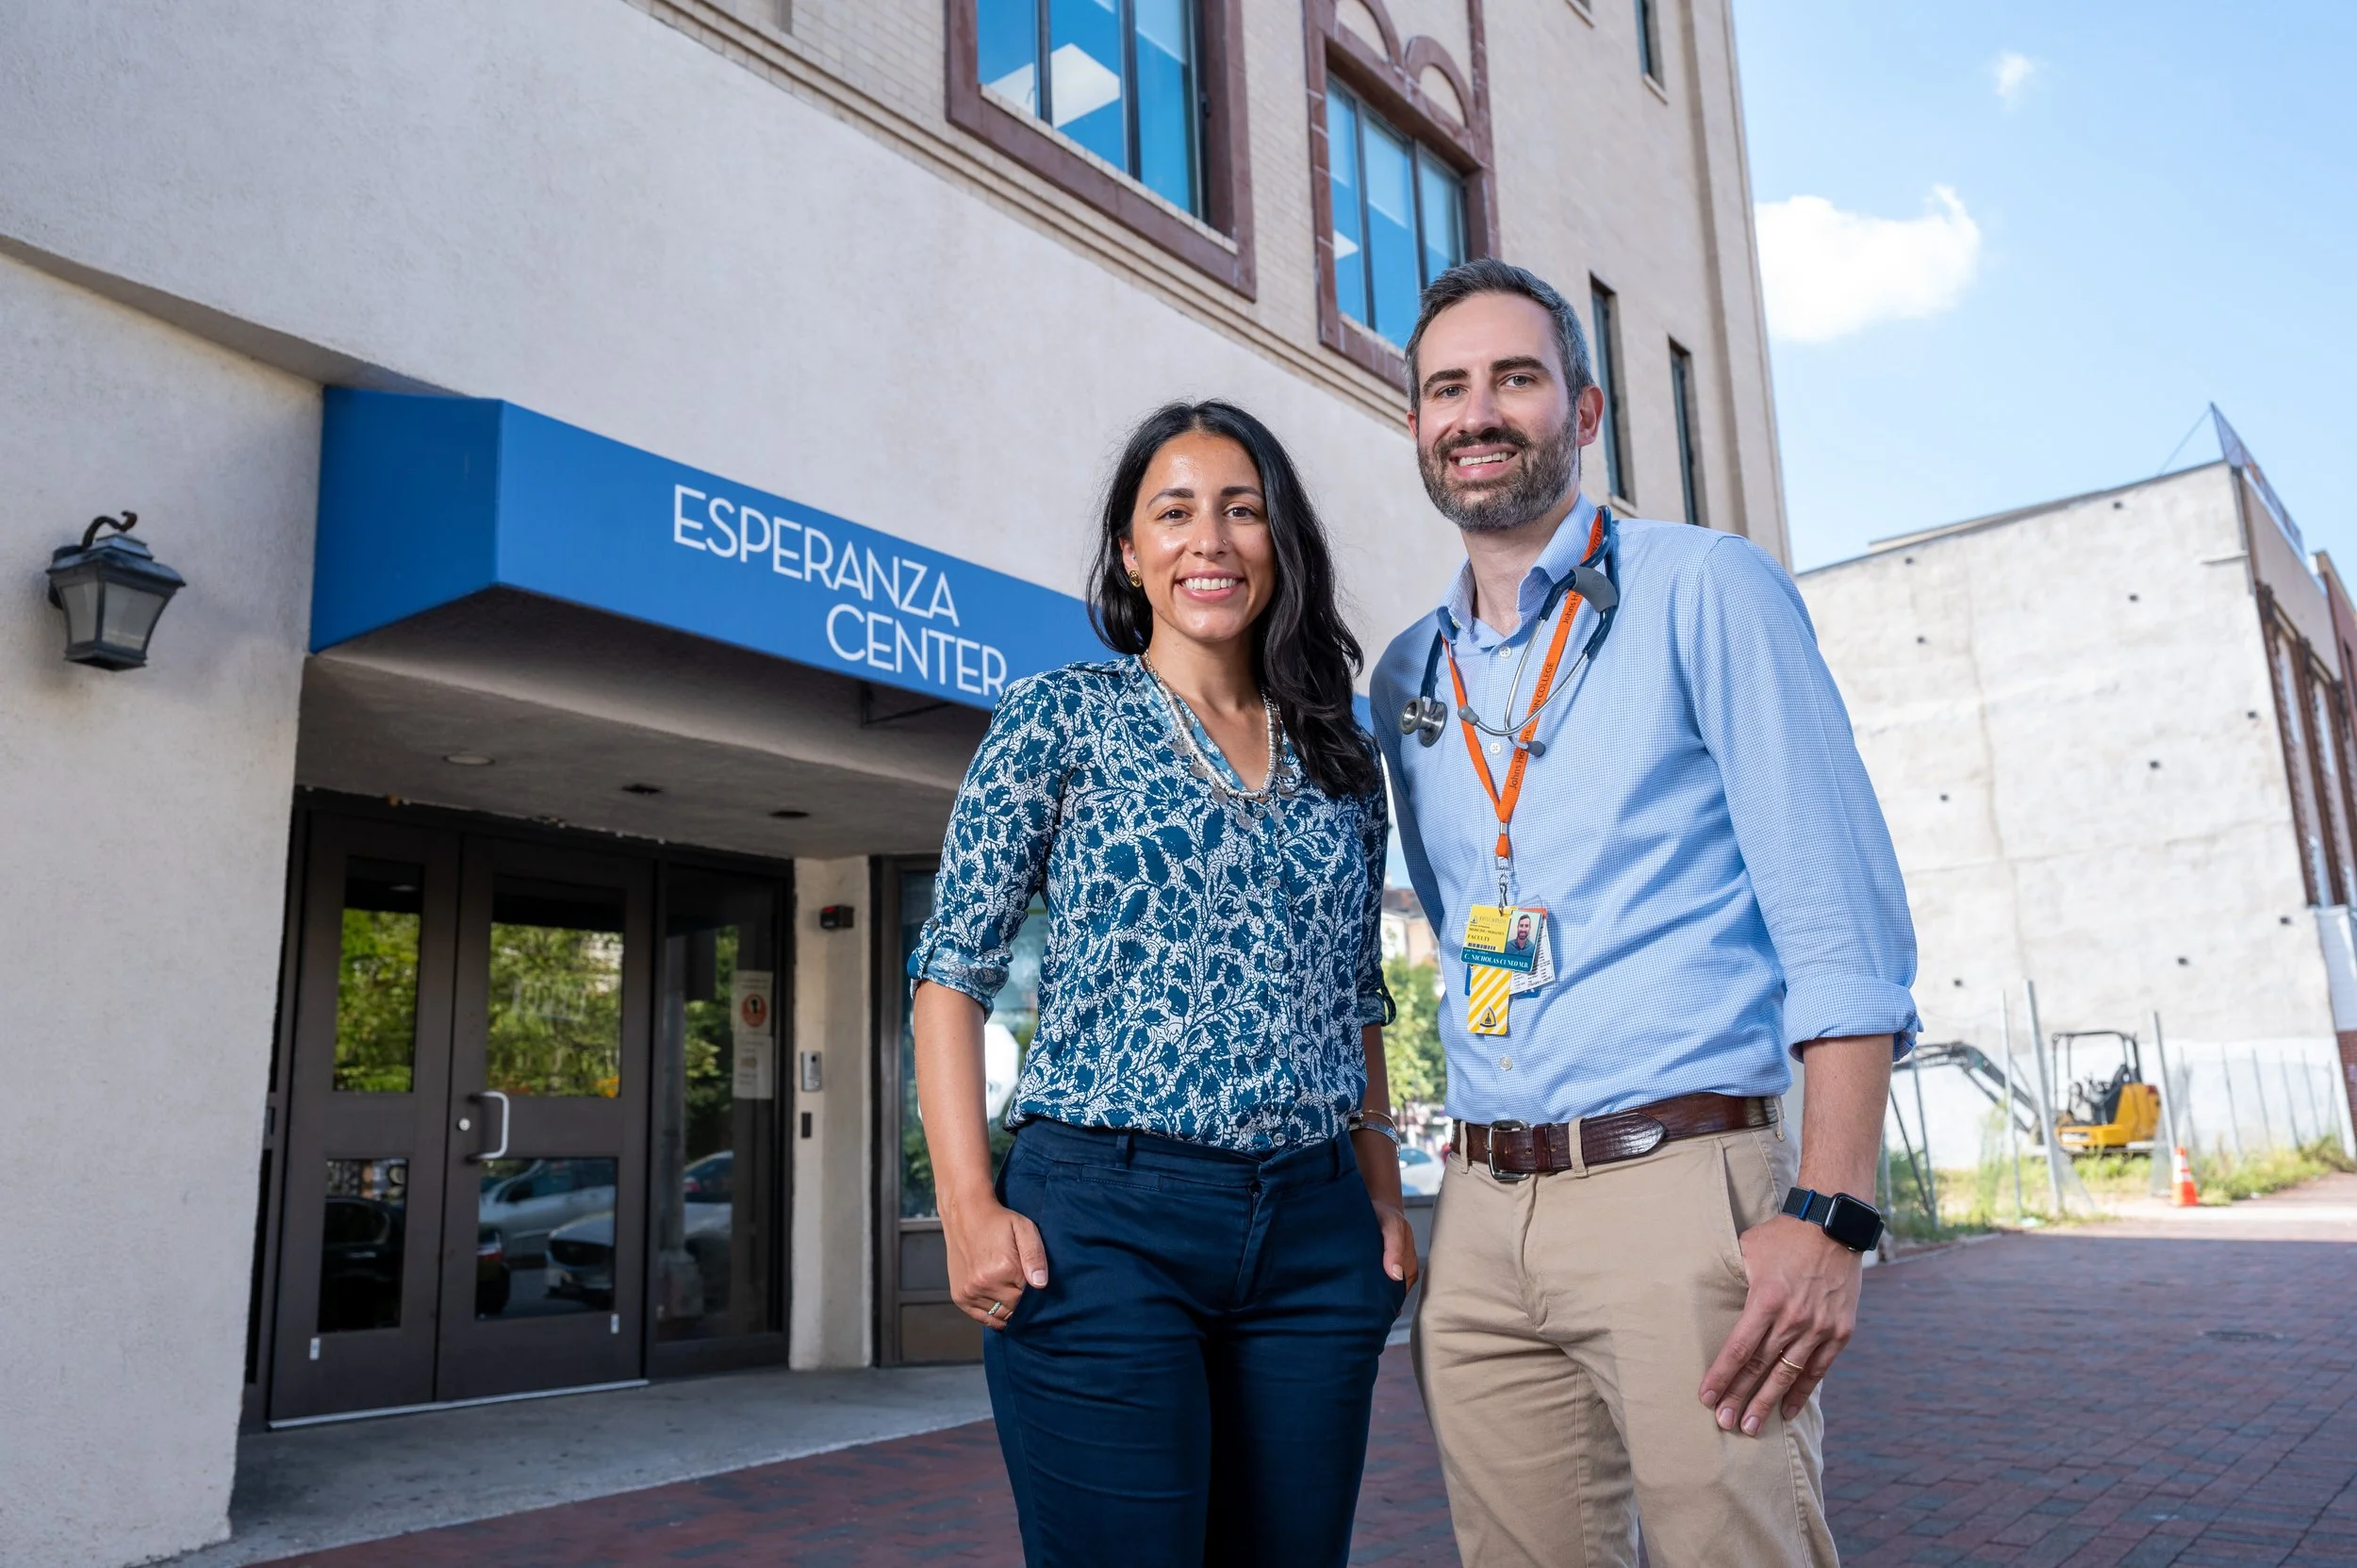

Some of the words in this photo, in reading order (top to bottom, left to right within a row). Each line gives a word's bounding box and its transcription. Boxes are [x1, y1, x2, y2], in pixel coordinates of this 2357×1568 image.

[674, 484, 960, 628] ESPERANZA
[826, 603, 1007, 696] CENTER
[1562, 602, 1576, 624] Johns
[1509, 765, 1521, 789] Johns
[1537, 662, 1555, 699] COLLEGE
[1472, 954, 1499, 964] NICHOLAS
